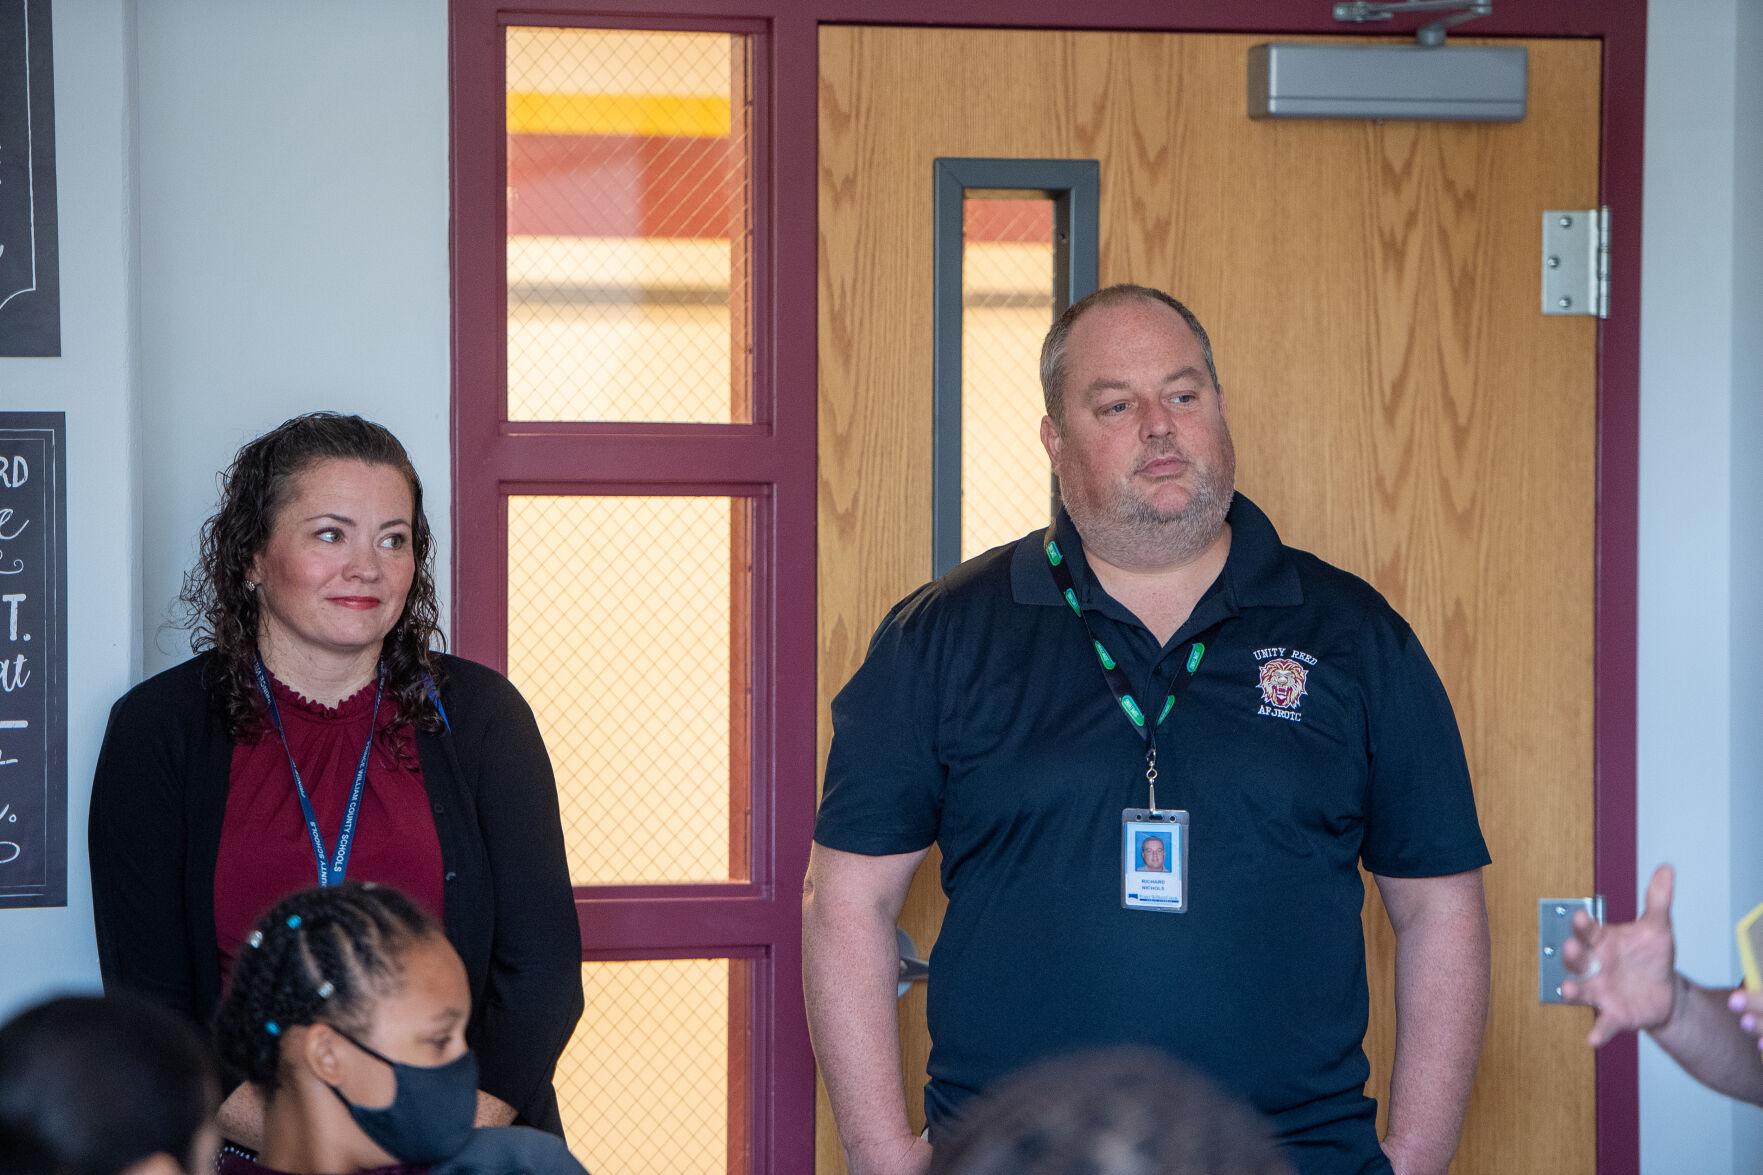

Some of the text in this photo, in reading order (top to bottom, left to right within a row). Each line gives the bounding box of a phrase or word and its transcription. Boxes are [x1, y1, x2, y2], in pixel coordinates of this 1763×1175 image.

[1253, 647, 1318, 666] UNITY REED
[1257, 705, 1302, 722] AFJROTC
[351, 769, 364, 800] WILLIAM
[343, 802, 357, 833] COUNTY
[310, 821, 325, 859] SCHOOLS
[333, 834, 349, 872] SCHOOLS
